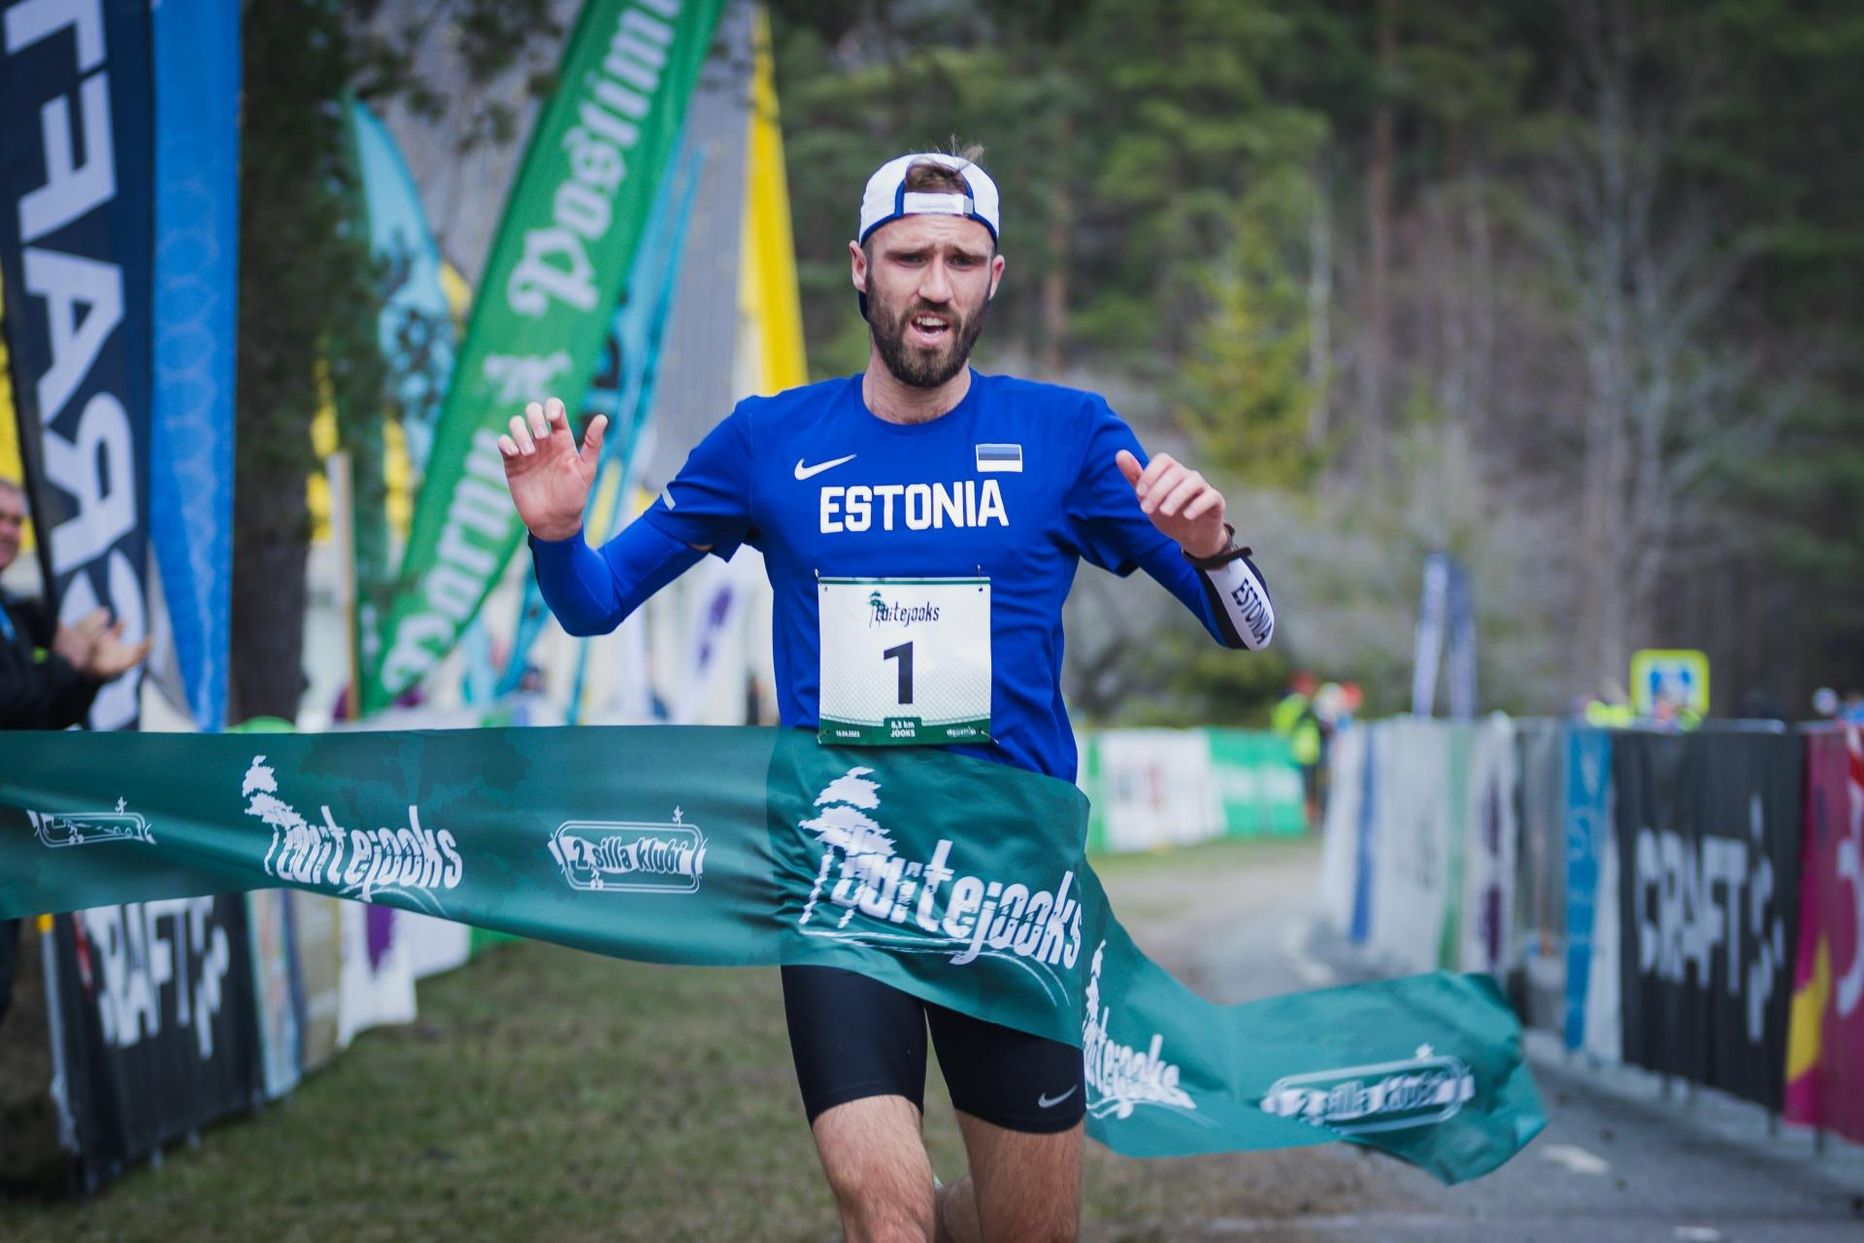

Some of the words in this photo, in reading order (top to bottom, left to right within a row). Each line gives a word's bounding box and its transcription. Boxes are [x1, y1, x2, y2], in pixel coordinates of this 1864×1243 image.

[819, 479, 1010, 535] ESTONIA
[1231, 577, 1273, 645] ESTONIA
[883, 641, 914, 704] 1
[890, 729, 916, 738] JOOKS
[903, 719, 915, 729] km
[572, 837, 591, 871] 2
[592, 835, 633, 871] silla
[635, 836, 689, 875] klubi
[1634, 826, 1748, 997] CRAFT
